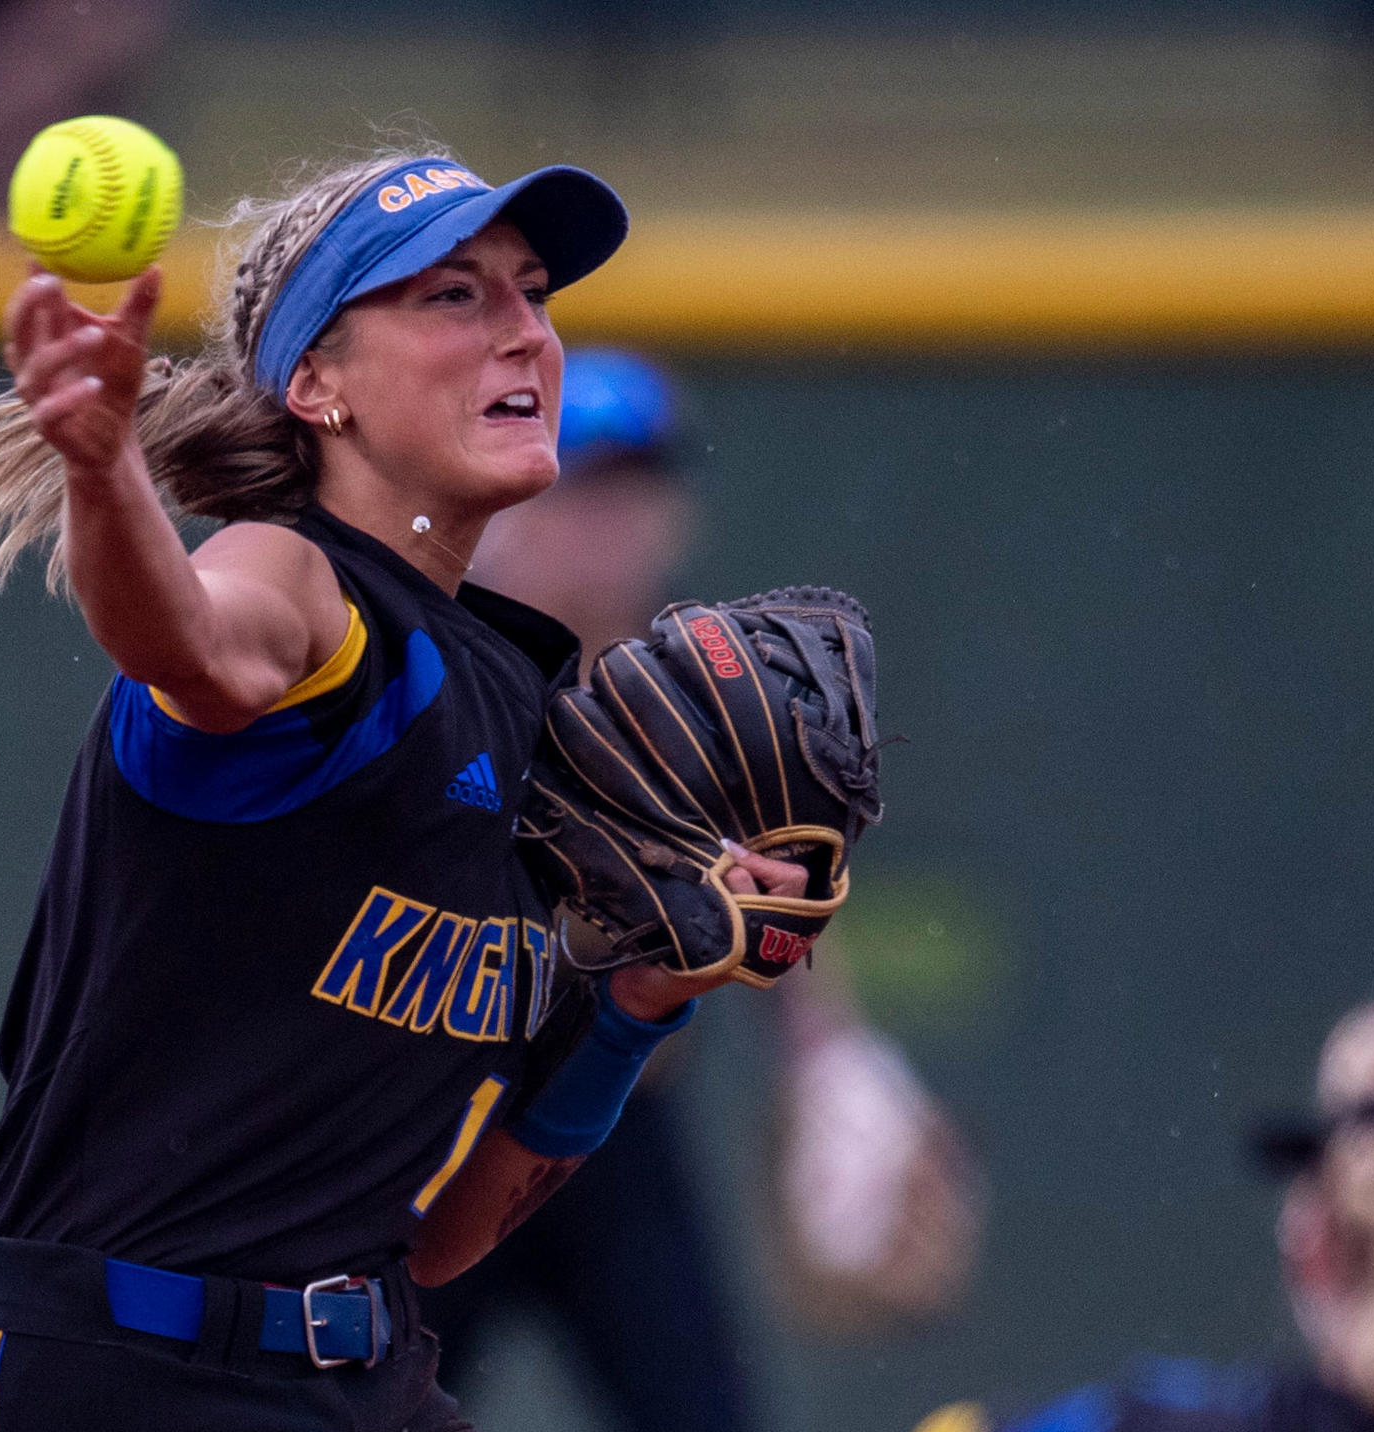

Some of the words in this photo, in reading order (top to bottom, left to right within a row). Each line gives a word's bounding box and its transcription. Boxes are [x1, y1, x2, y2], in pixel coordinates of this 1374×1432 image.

[378, 168, 496, 213] CAST
[687, 615, 743, 679] A2000
[310, 884, 558, 1042] KNGHT
[409, 1071, 510, 1220] 1
